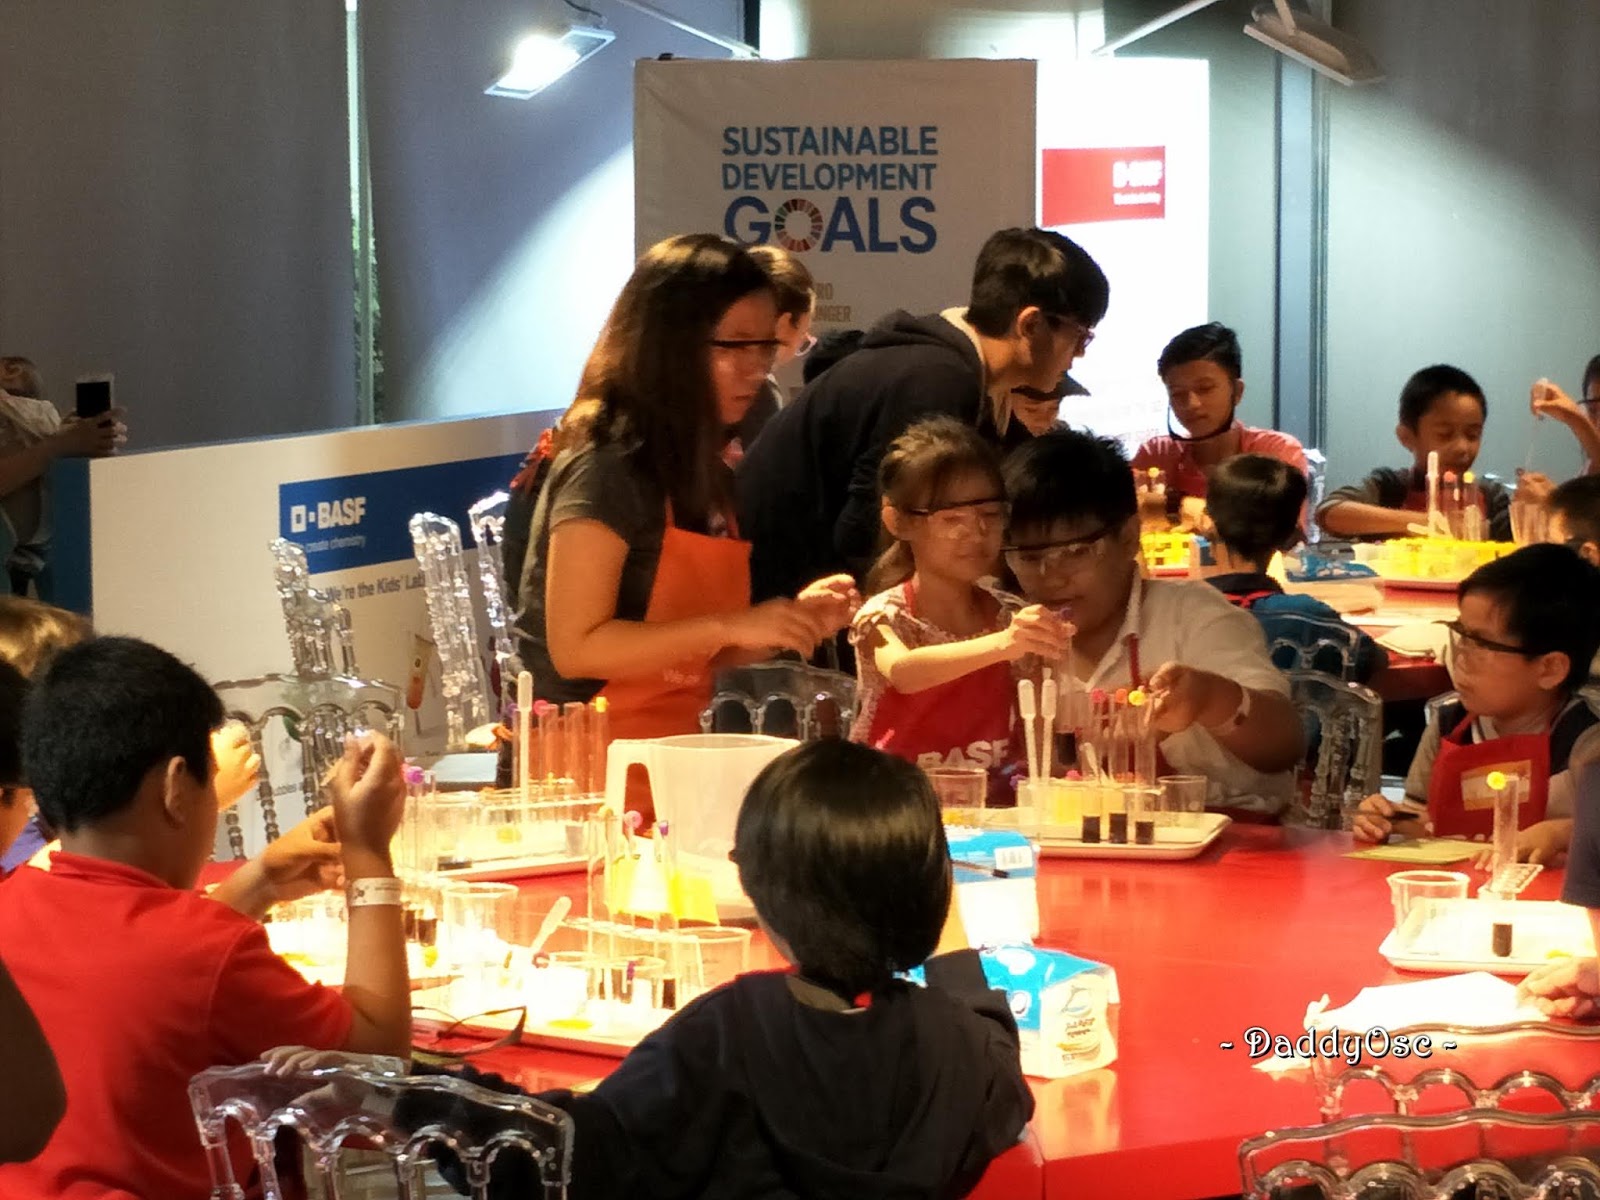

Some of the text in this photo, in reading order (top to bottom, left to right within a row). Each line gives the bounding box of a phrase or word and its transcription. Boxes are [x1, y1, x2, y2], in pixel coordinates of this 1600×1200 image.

[722, 126, 938, 156] SUSTAINABLE
[721, 163, 937, 190] DEVELOPMENT
[724, 195, 937, 254] GOALS
[317, 497, 367, 529] BASF
[357, 581, 375, 598] the
[916, 738, 1009, 769] BASF
